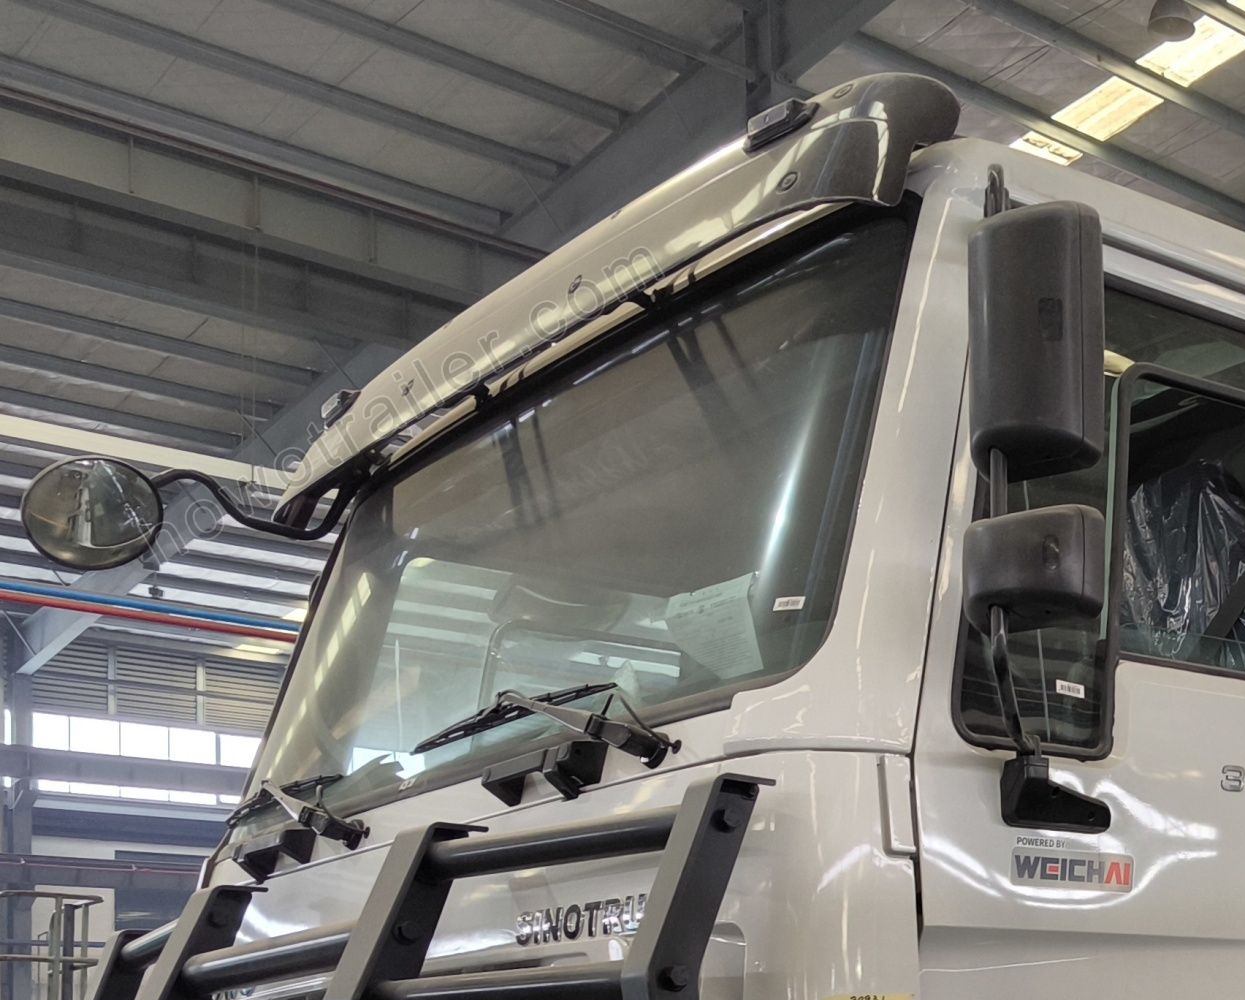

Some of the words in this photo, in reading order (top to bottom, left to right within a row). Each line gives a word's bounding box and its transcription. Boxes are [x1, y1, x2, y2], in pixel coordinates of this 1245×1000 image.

[1016, 836, 1055, 848] POWERED
[1055, 840, 1066, 848] BY
[1014, 854, 1131, 885] WEICHAI
[515, 893, 648, 946] SINOTRU
